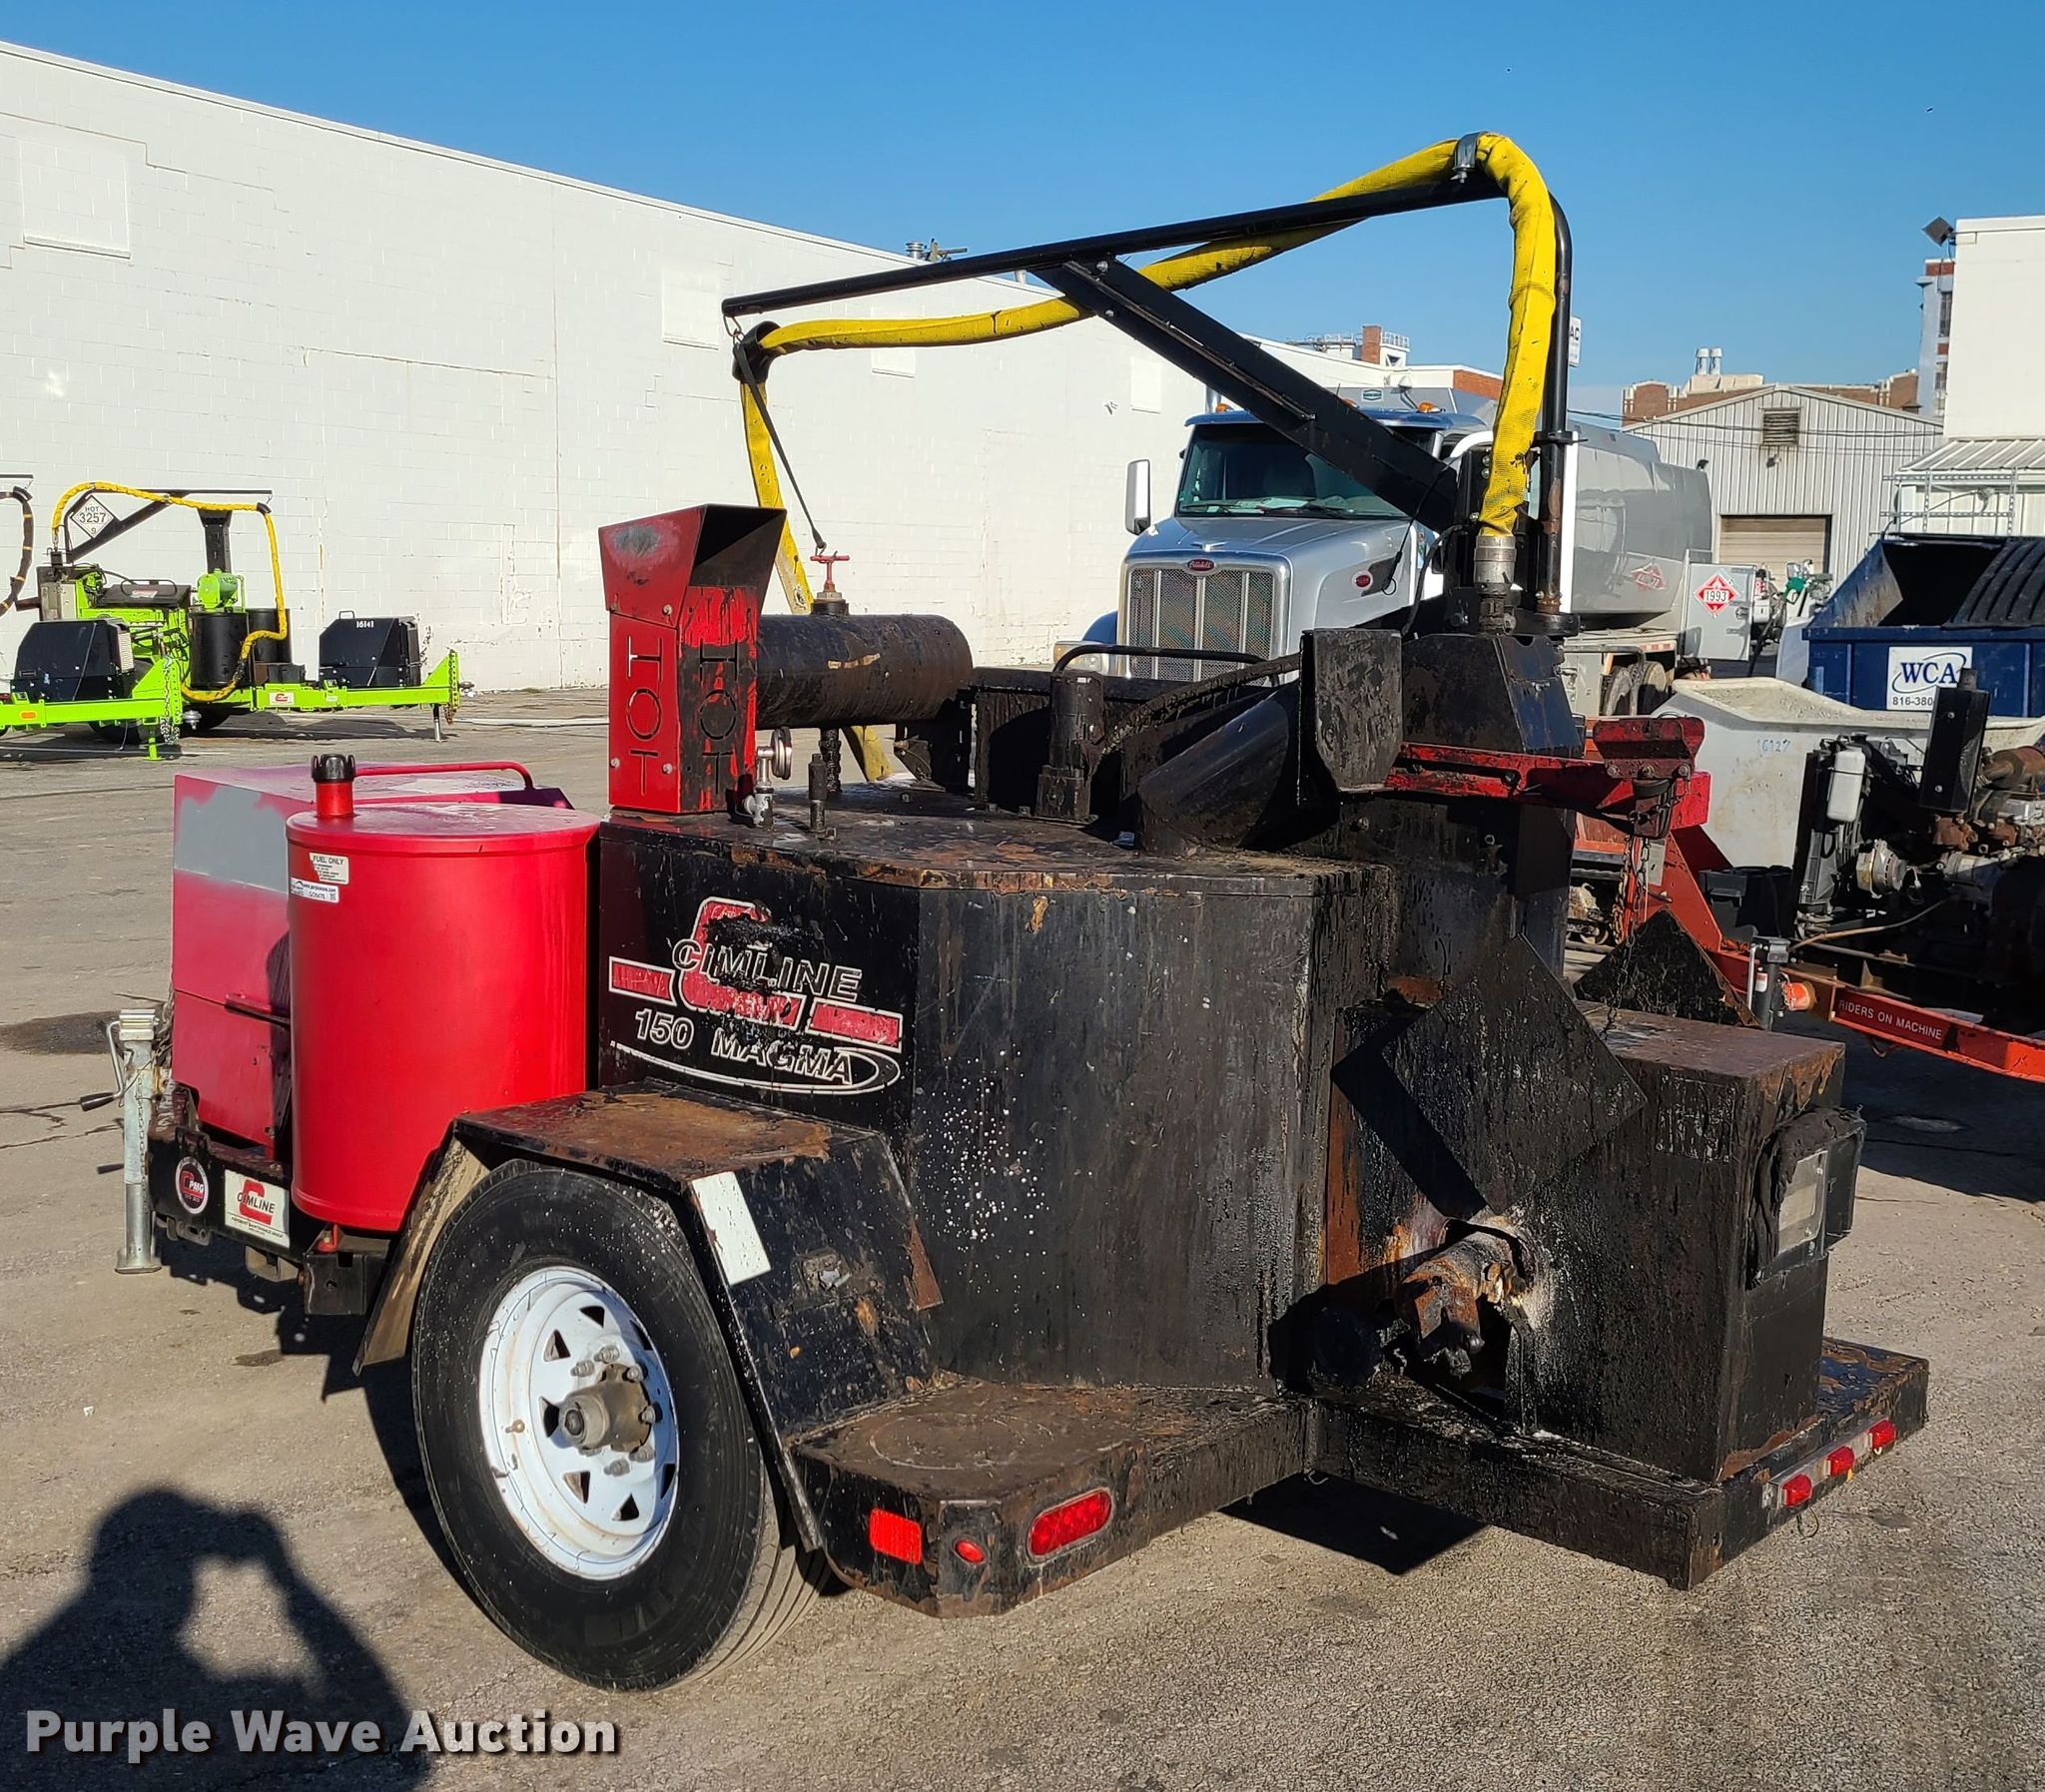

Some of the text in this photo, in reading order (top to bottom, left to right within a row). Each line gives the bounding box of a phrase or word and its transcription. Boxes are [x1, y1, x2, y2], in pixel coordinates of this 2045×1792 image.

[79, 512, 106, 523] 3257
[1705, 591, 1726, 602] 1993
[1900, 662, 1958, 684] WCA
[329, 857, 344, 866] ONLY
[672, 938, 862, 1001] CIMLINE
[1838, 999, 1942, 1040] RIDERS ON MACHINE
[635, 1008, 853, 1086] 150 MAGMA
[189, 1181, 205, 1193] PMG
[237, 1192, 276, 1214] CIMLINE
